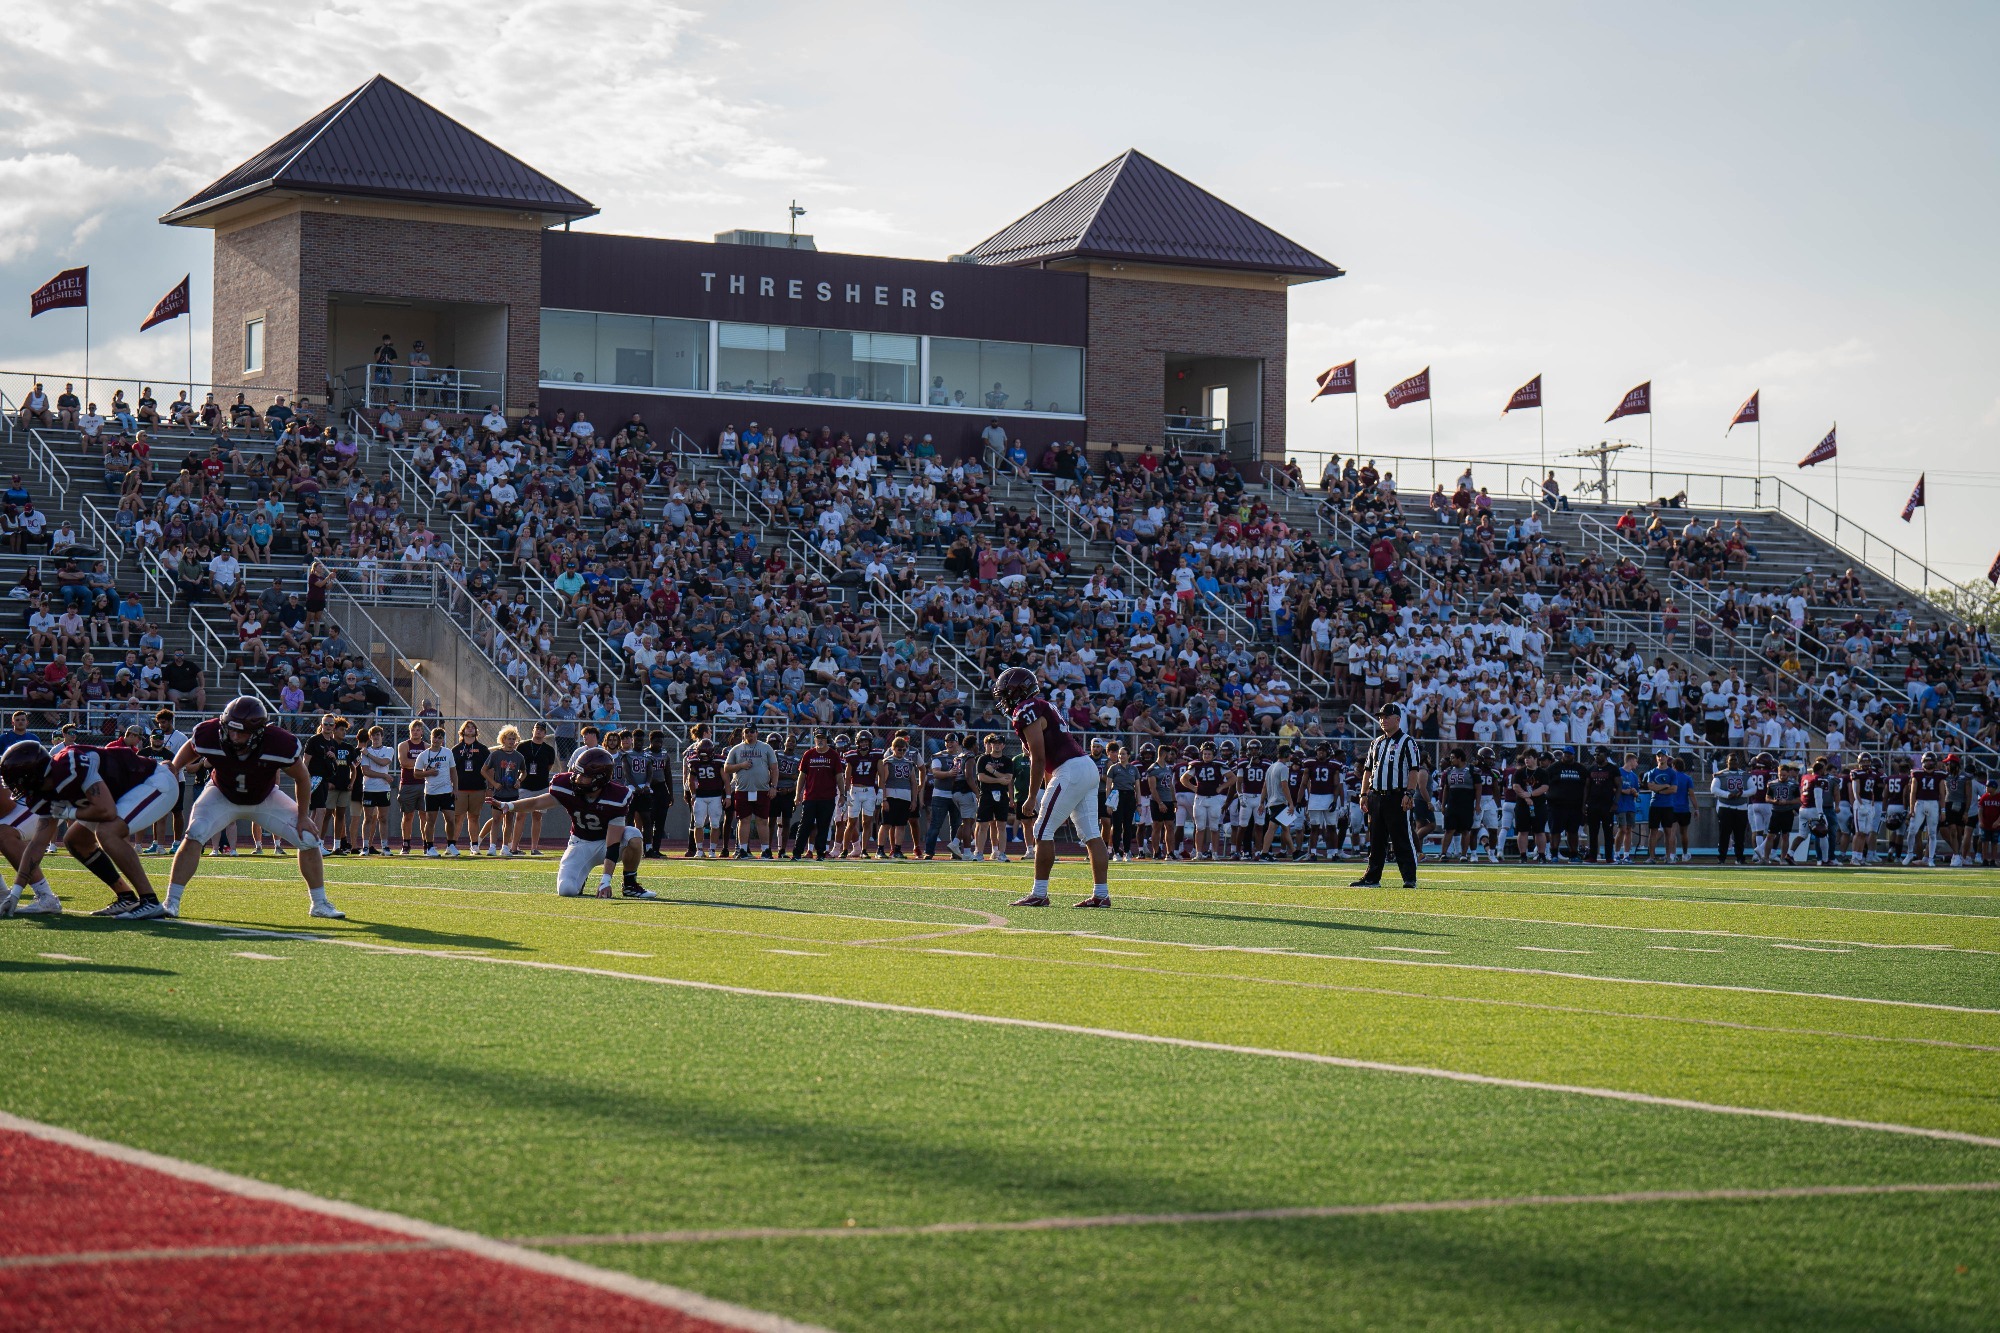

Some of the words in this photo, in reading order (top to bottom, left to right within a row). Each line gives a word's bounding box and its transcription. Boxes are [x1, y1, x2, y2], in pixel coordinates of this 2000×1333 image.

[35, 289, 82, 307] THRESHERS
[701, 272, 945, 310] THRESHERS
[28, 518, 39, 528] BC
[1023, 709, 1037, 725] 37
[632, 758, 646, 773] 81
[698, 767, 715, 778] 26
[856, 762, 872, 775] 47
[1199, 767, 1215, 781] 42
[1248, 768, 1264, 781] 80
[1315, 767, 1328, 781] 13
[236, 774, 248, 793] 1
[1889, 778, 1902, 792] 65
[1922, 778, 1934, 790] 14
[1776, 786, 1789, 799] 13
[574, 811, 602, 831] 12
